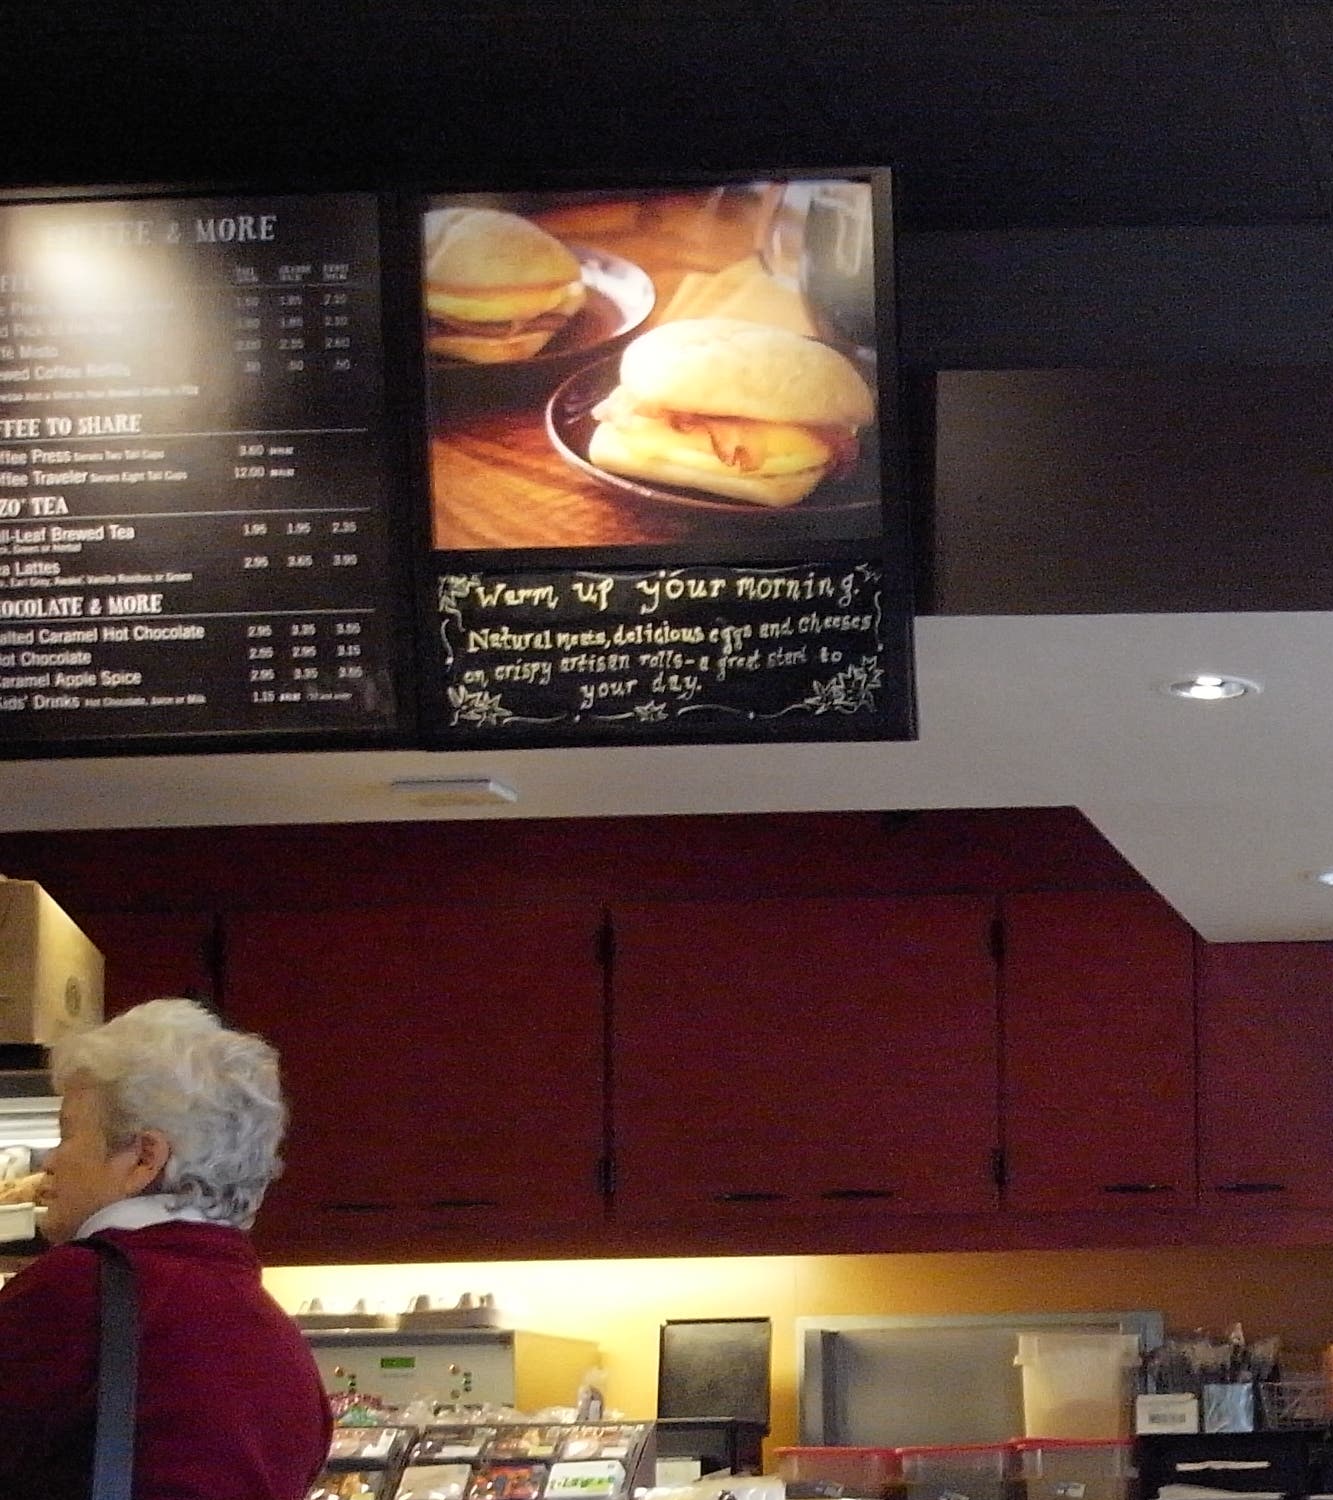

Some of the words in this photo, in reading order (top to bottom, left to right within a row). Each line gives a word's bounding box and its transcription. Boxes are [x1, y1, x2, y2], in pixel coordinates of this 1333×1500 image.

[196, 215, 277, 242] MORE
[0, 417, 41, 438] FEE
[47, 416, 72, 436] TO
[77, 413, 142, 435] SHARE
[30, 448, 72, 465] Press
[32, 470, 88, 486] Traveler
[30, 496, 69, 516] TEA
[51, 525, 105, 542] Brewed
[109, 524, 135, 540] Tea
[15, 561, 61, 576] Lattes
[90, 598, 102, 615] &
[108, 594, 163, 615] MORE
[571, 577, 614, 611] up
[636, 577, 727, 615] your
[38, 628, 98, 644] Caramel
[102, 626, 129, 642] Hot
[133, 624, 205, 641] Chocolate
[467, 625, 552, 653] Natural
[759, 616, 794, 639] and
[20, 650, 92, 667] Chocolate
[494, 658, 553, 685] crispy
[559, 653, 630, 674] artisan
[819, 646, 843, 664] to
[54, 671, 97, 688] Apple
[101, 670, 142, 687] Spice
[32, 694, 81, 710] Drinks
[579, 679, 639, 710] your
